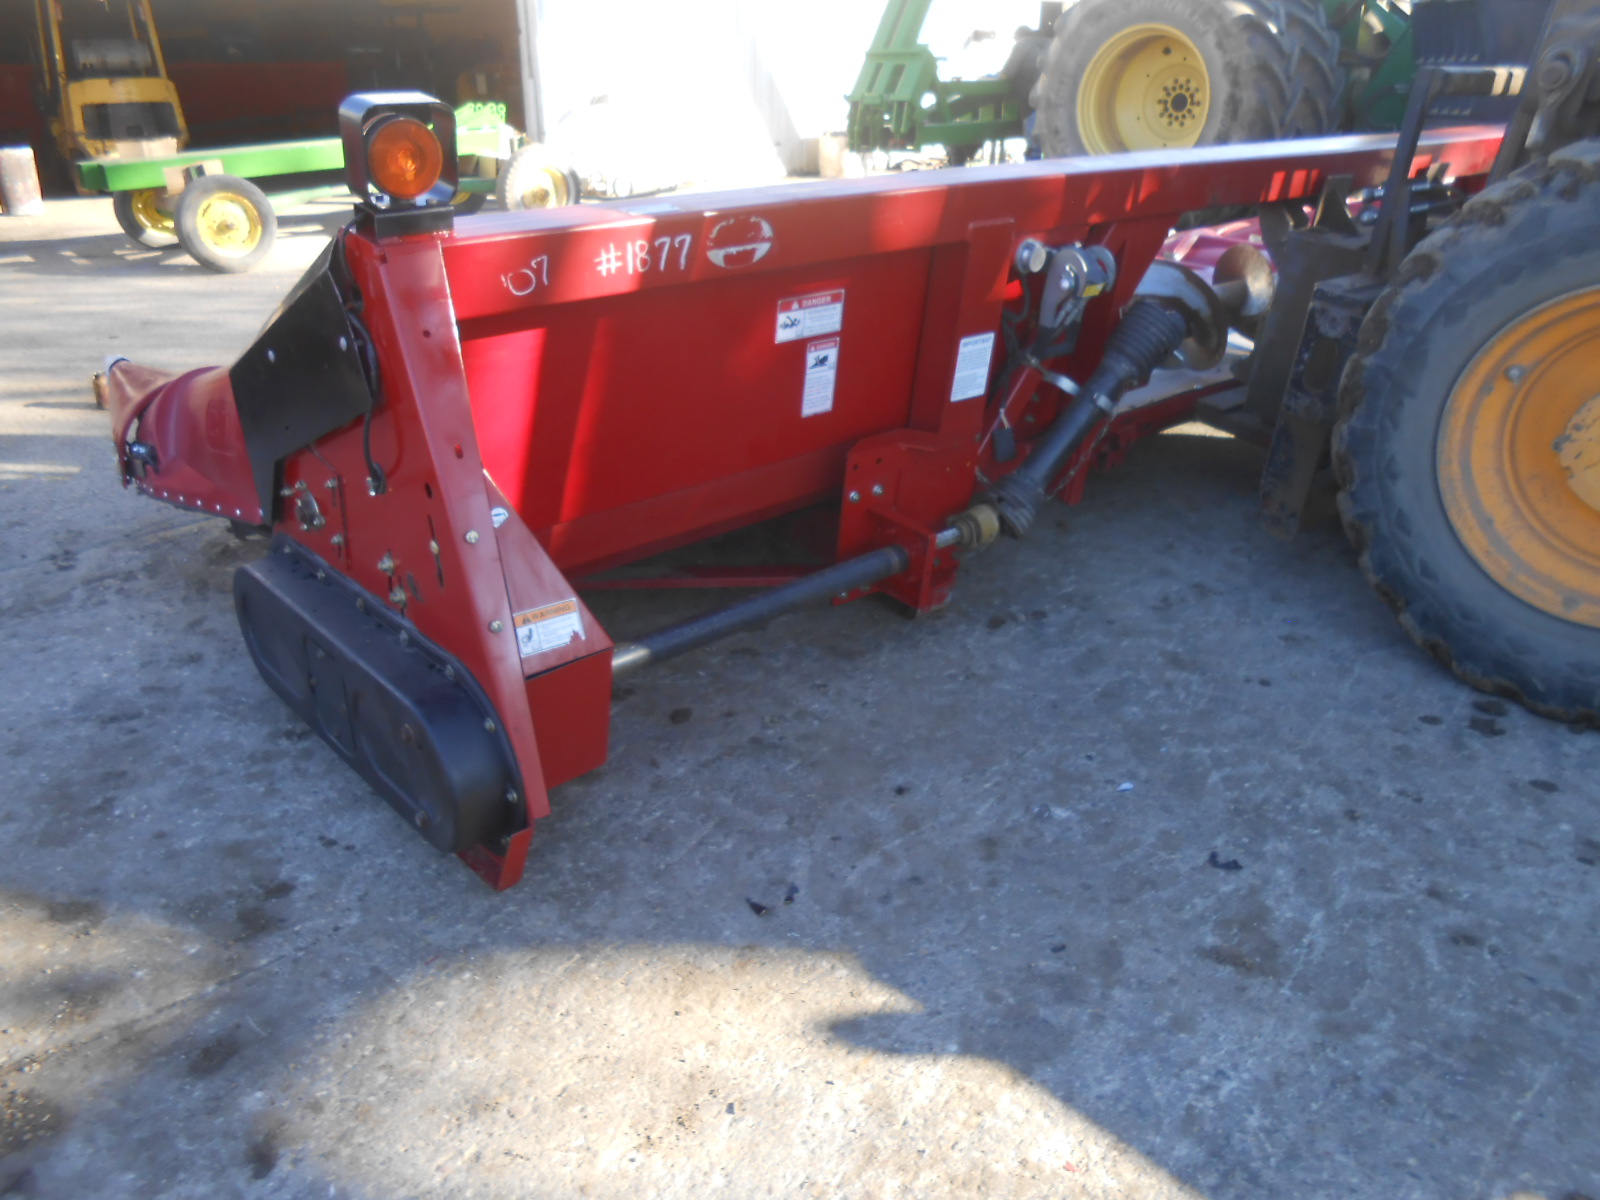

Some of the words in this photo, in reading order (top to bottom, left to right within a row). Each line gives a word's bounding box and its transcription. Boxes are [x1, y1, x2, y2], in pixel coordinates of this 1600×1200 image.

[594, 233, 692, 277] #1877
[802, 296, 832, 308] DANGER
[532, 604, 571, 619] WARNING
